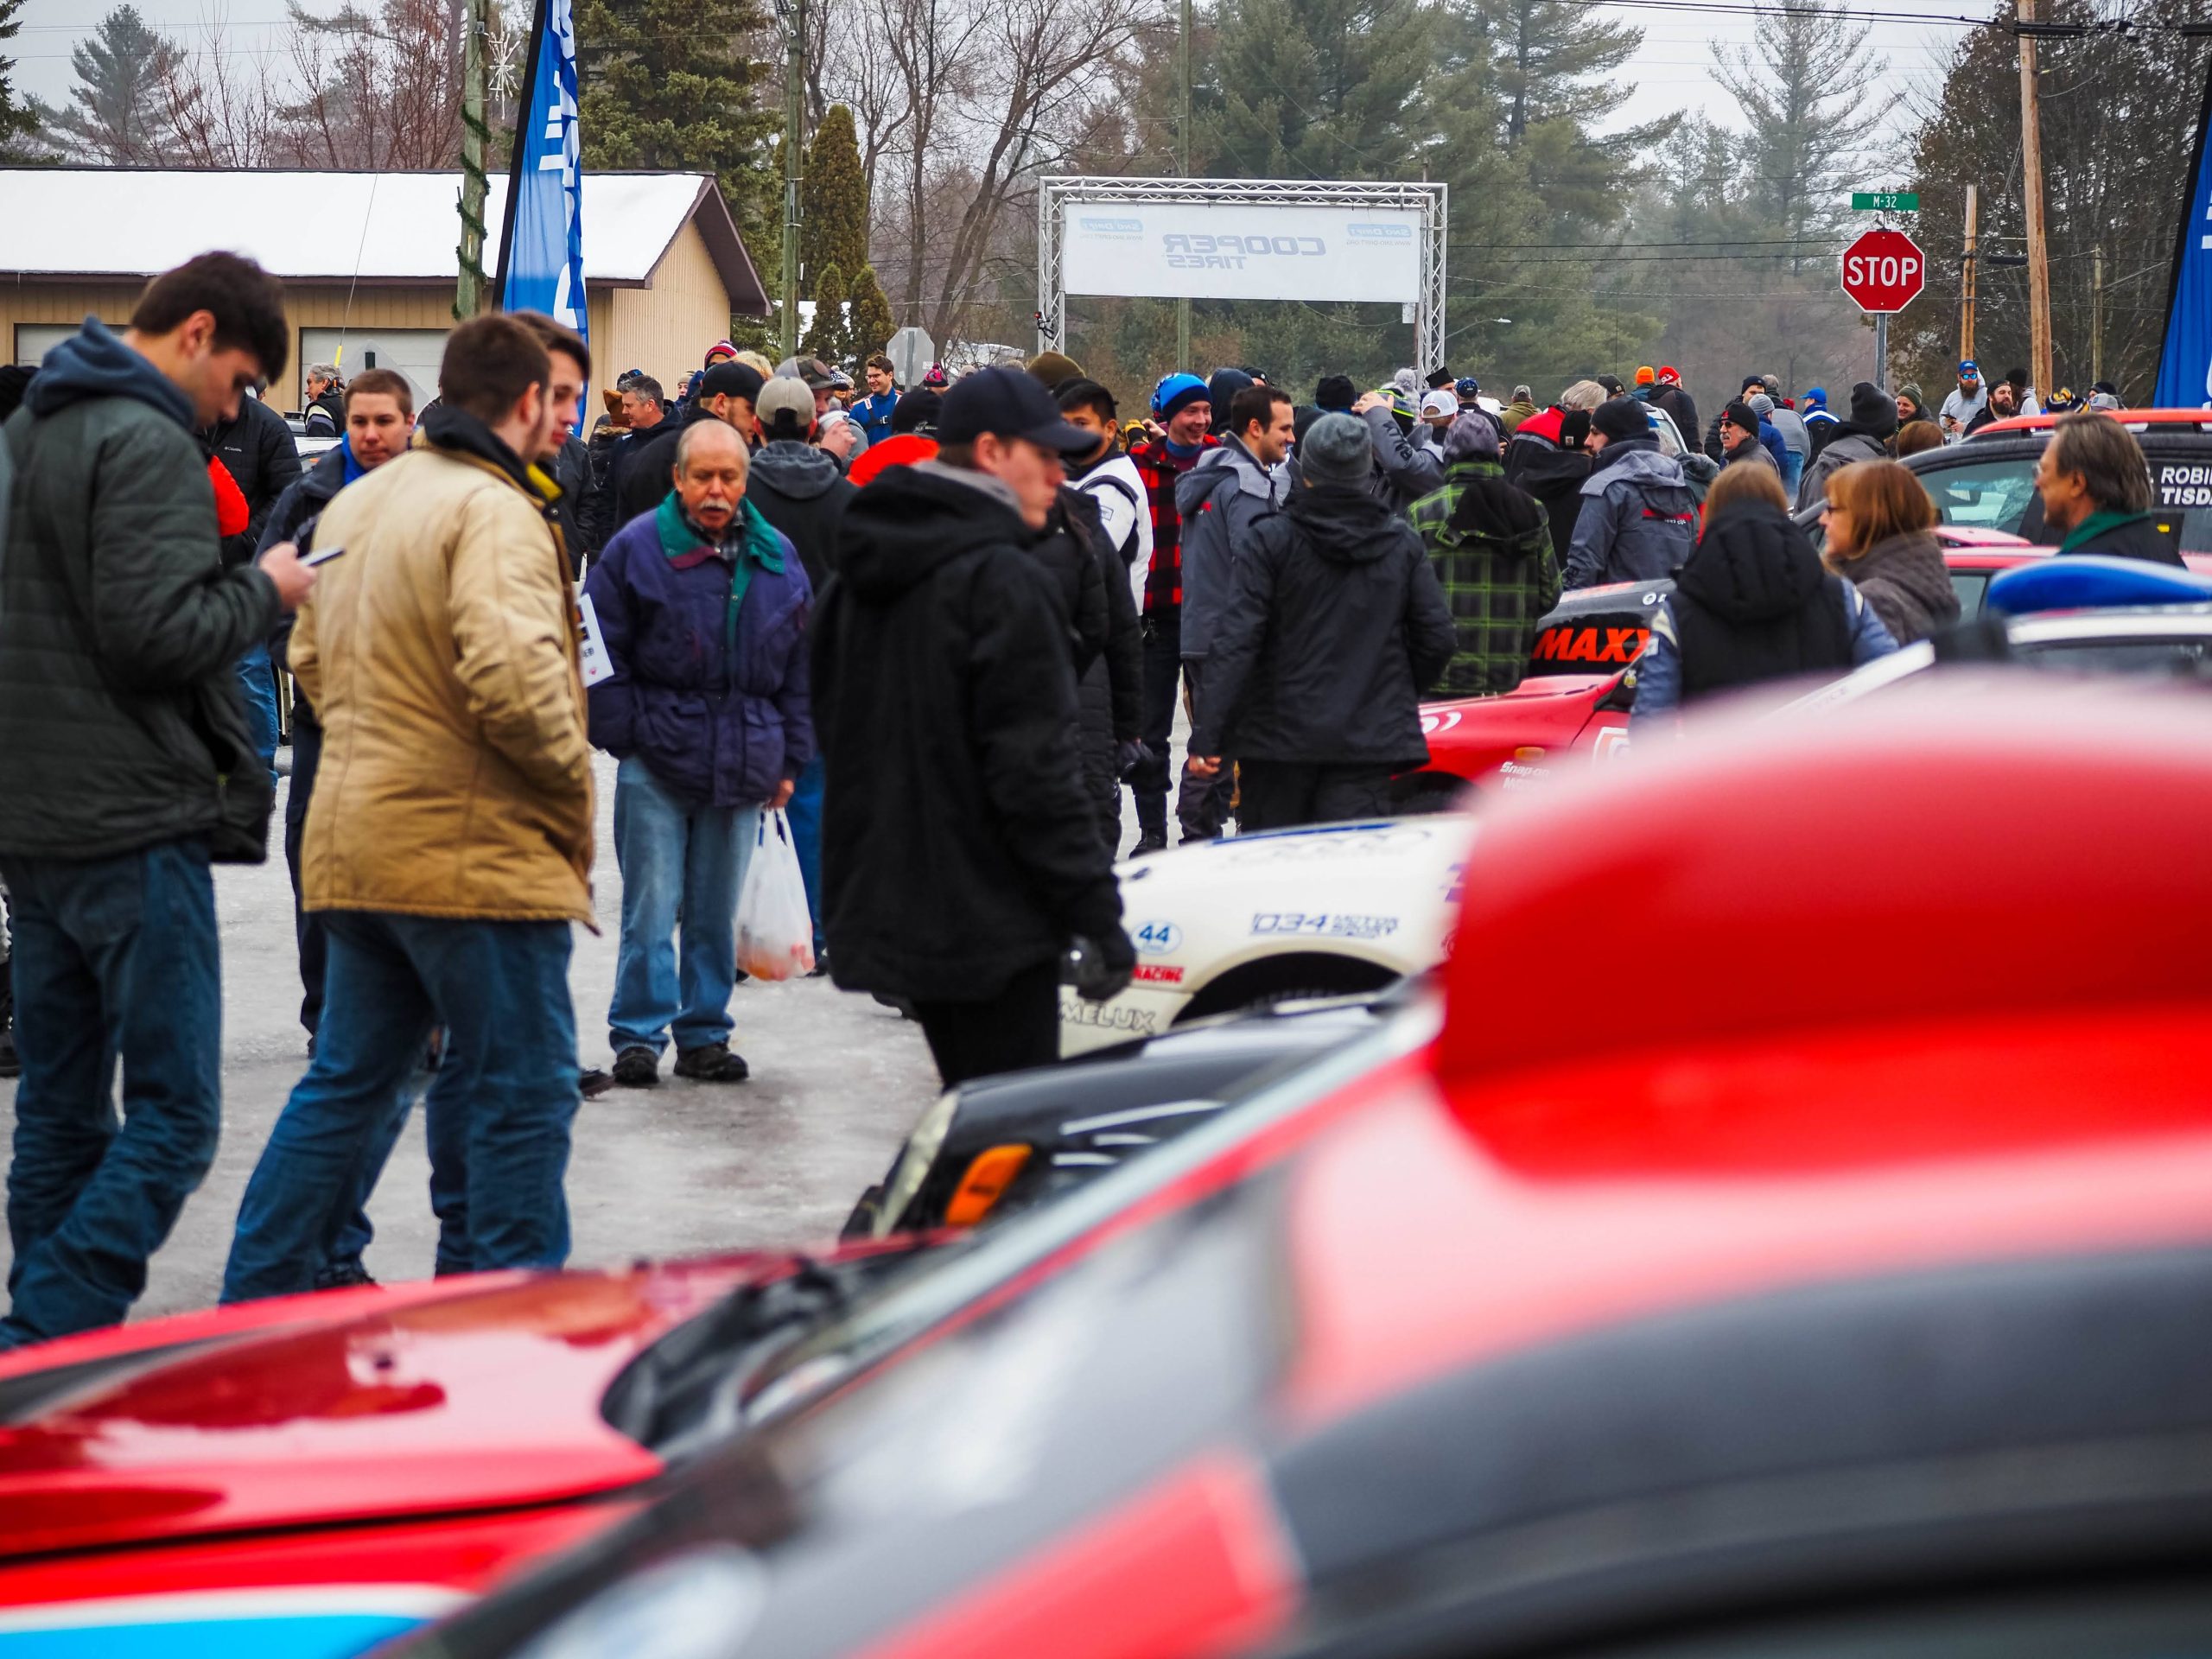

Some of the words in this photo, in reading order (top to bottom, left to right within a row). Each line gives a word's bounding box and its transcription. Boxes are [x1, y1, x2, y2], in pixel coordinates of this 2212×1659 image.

[1872, 195, 1897, 208] M-32
[1847, 256, 1918, 287] STOP
[1139, 925, 1170, 943] 44
